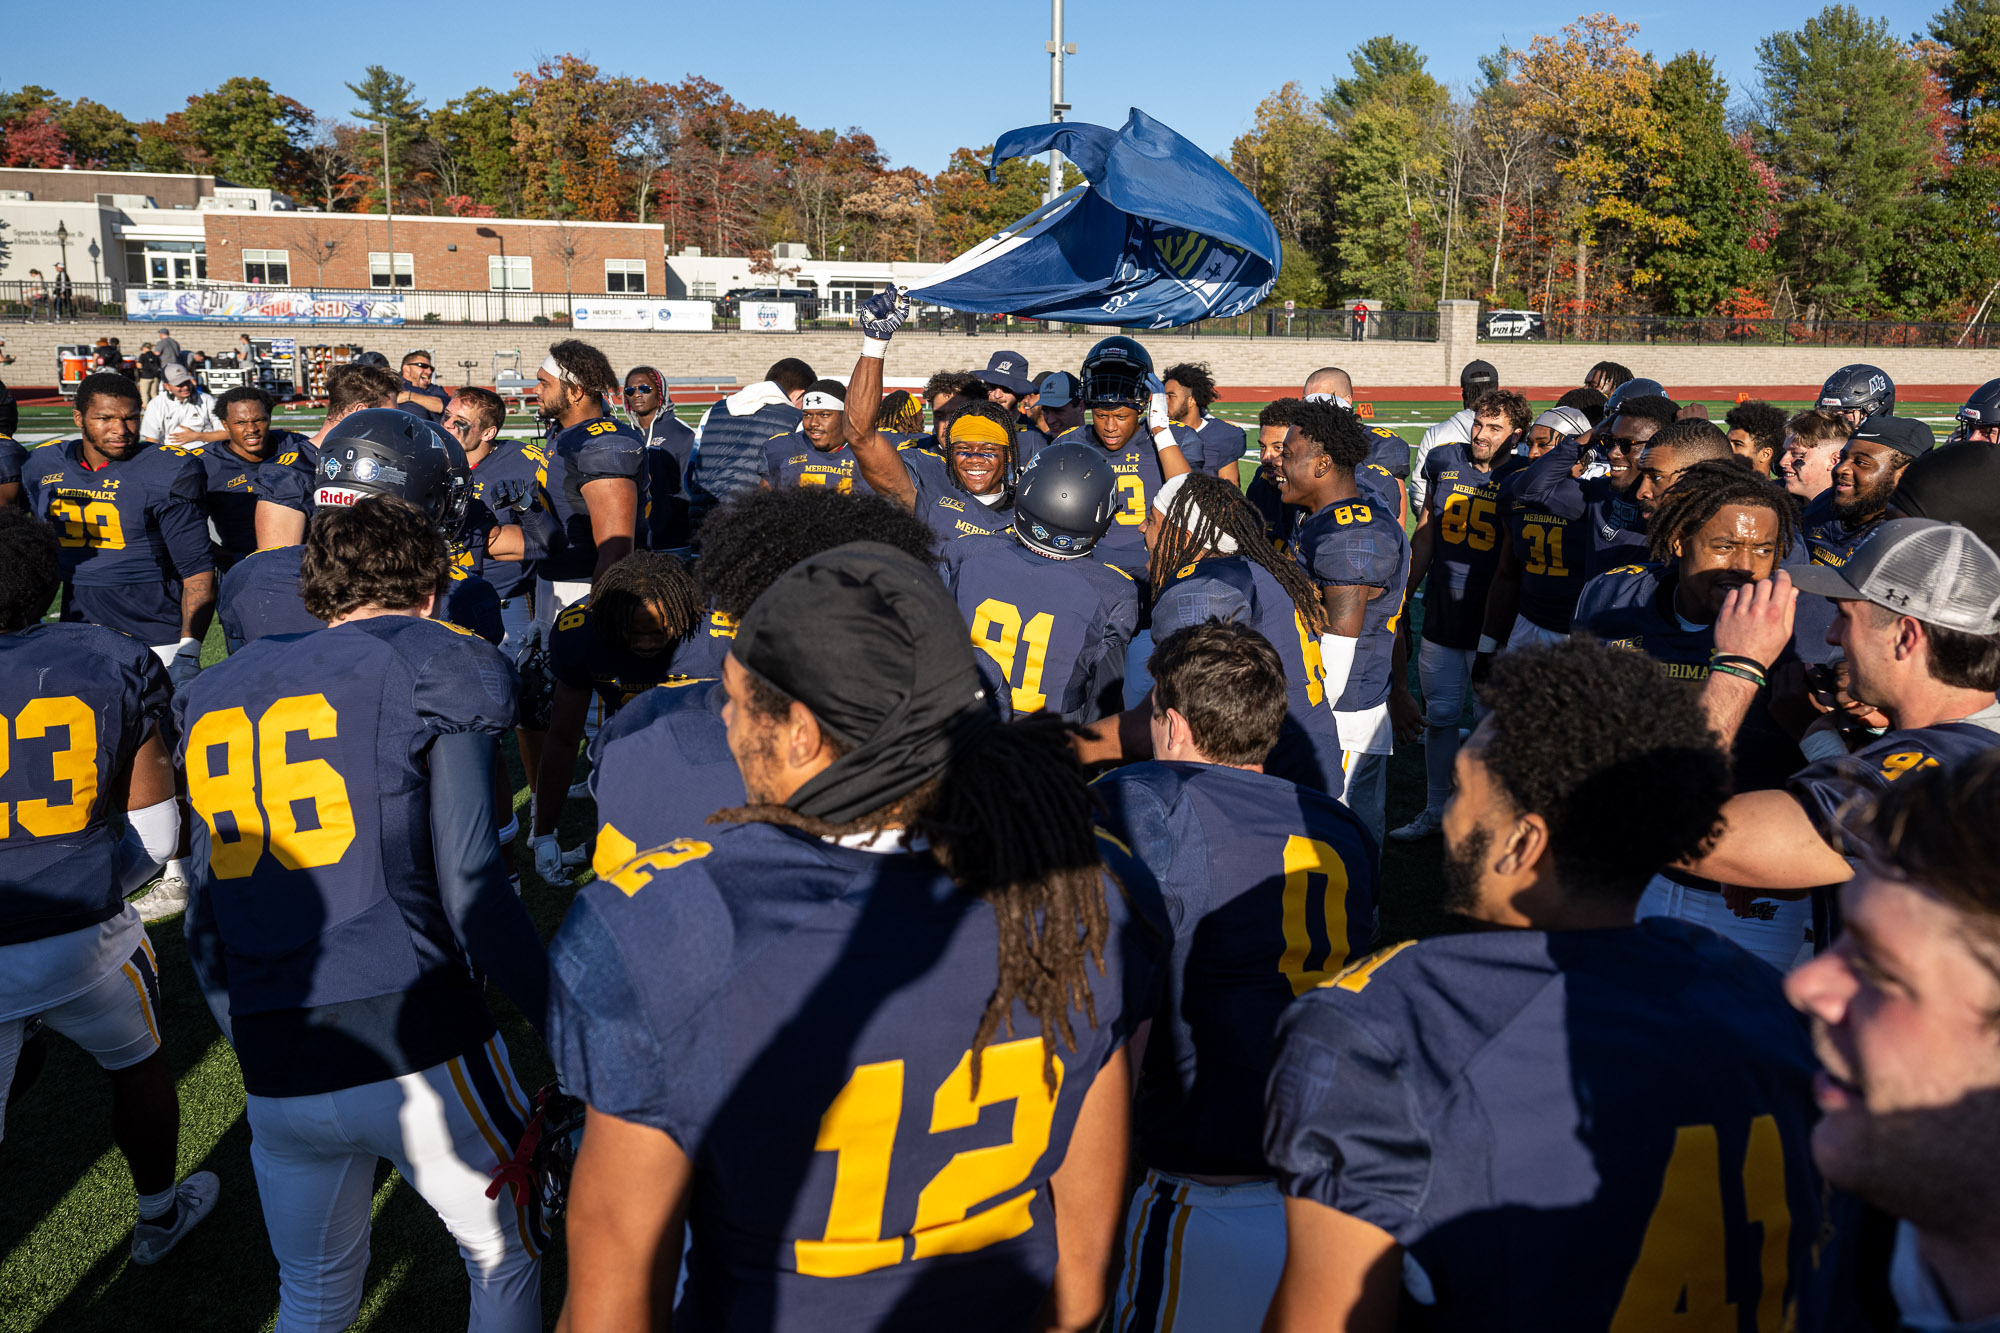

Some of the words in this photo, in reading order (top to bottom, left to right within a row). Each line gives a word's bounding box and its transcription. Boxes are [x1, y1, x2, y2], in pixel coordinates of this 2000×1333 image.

[13, 229, 38, 237] Sports
[202, 291, 229, 309] FDU
[261, 300, 291, 316] SHU
[314, 301, 345, 317] SFU
[1361, 405, 1372, 415] 20
[586, 421, 618, 435] 56
[346, 449, 354, 460] 0
[804, 465, 853, 476] MERRIMACK
[1441, 471, 1459, 480] NEC
[41, 473, 64, 485] NEC
[228, 474, 248, 488] NEC
[56, 487, 117, 501] MERRIMACK
[320, 490, 360, 507] Ridd
[1115, 474, 1147, 526] 3
[939, 497, 965, 509] NEC
[1334, 504, 1373, 525] 83
[1441, 492, 1497, 551] 85
[1523, 513, 1568, 526] MERRIMACK
[51, 499, 126, 550] 39
[1521, 523, 1569, 577] 31
[0, 696, 98, 838] 3
[185, 693, 356, 881] 86
[1278, 834, 1349, 997] 0
[794, 1036, 1065, 1279] 12
[1609, 1113, 1792, 1333] 41
